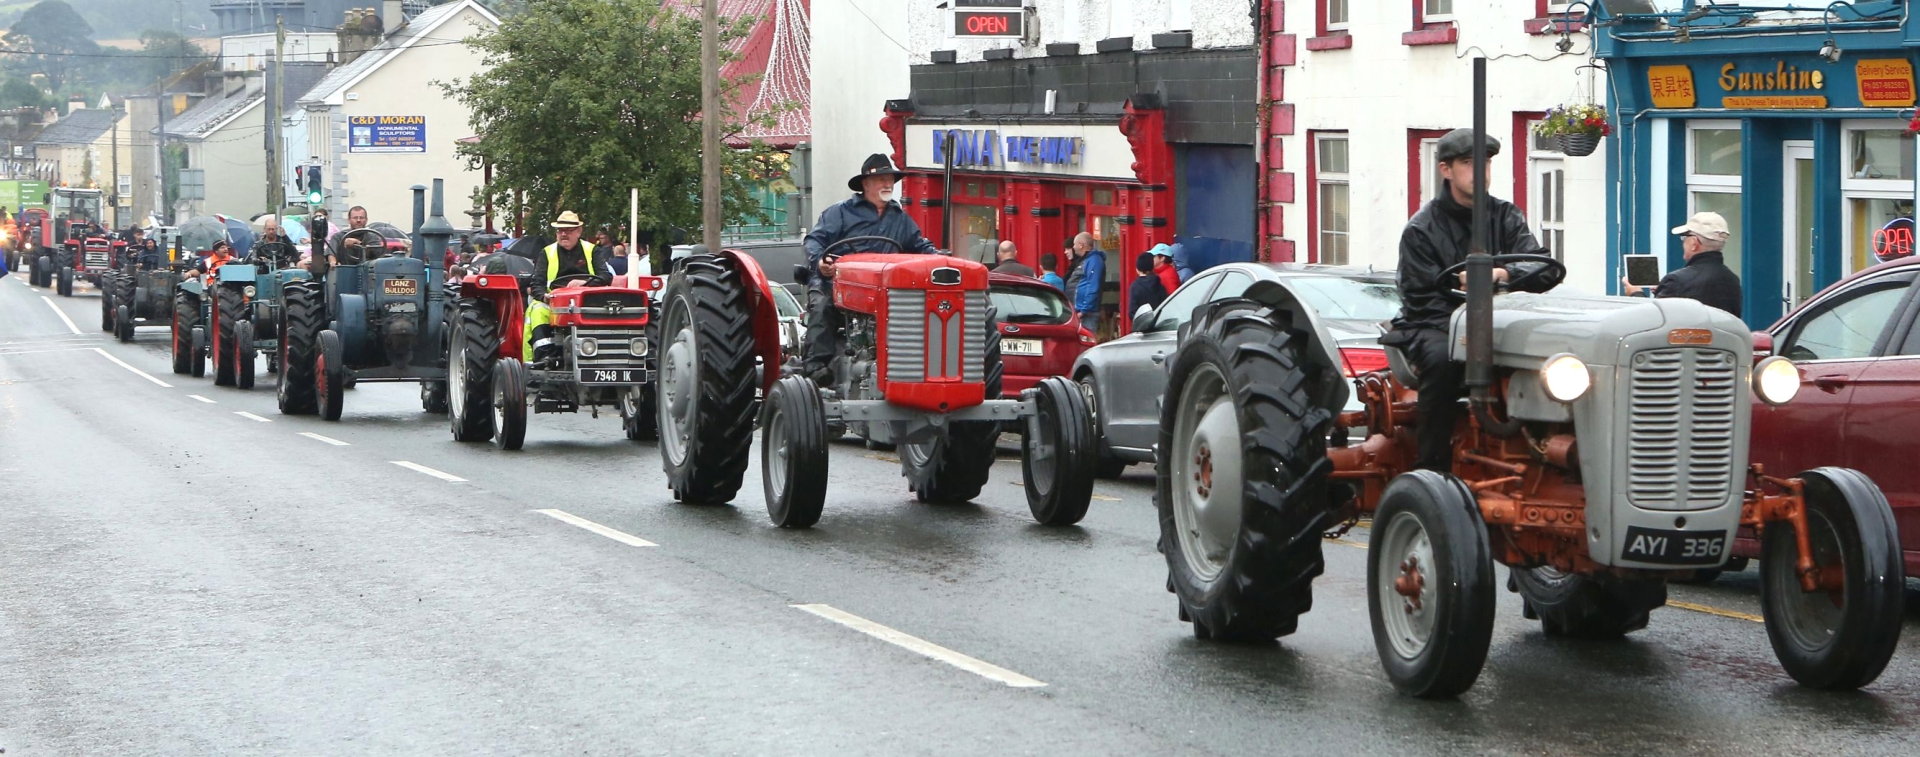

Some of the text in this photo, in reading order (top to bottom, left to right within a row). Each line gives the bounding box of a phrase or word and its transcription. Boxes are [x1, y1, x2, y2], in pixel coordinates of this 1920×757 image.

[967, 15, 1007, 33] OPEN
[1718, 61, 1823, 91] Sunshine
[1858, 64, 1909, 78] Delivery Service
[1746, 97, 1767, 106] Chinese
[1767, 97, 1780, 106] Take
[1780, 97, 1794, 108] Away
[351, 116, 423, 125] C&D MORAN
[933, 129, 1081, 166] ROMA TAKE AWAY
[1873, 227, 1914, 255] OPEN
[1001, 341, 1032, 352] 1-WW-711
[595, 370, 631, 382] 7948 IK
[1629, 534, 1723, 557] AYI 336
